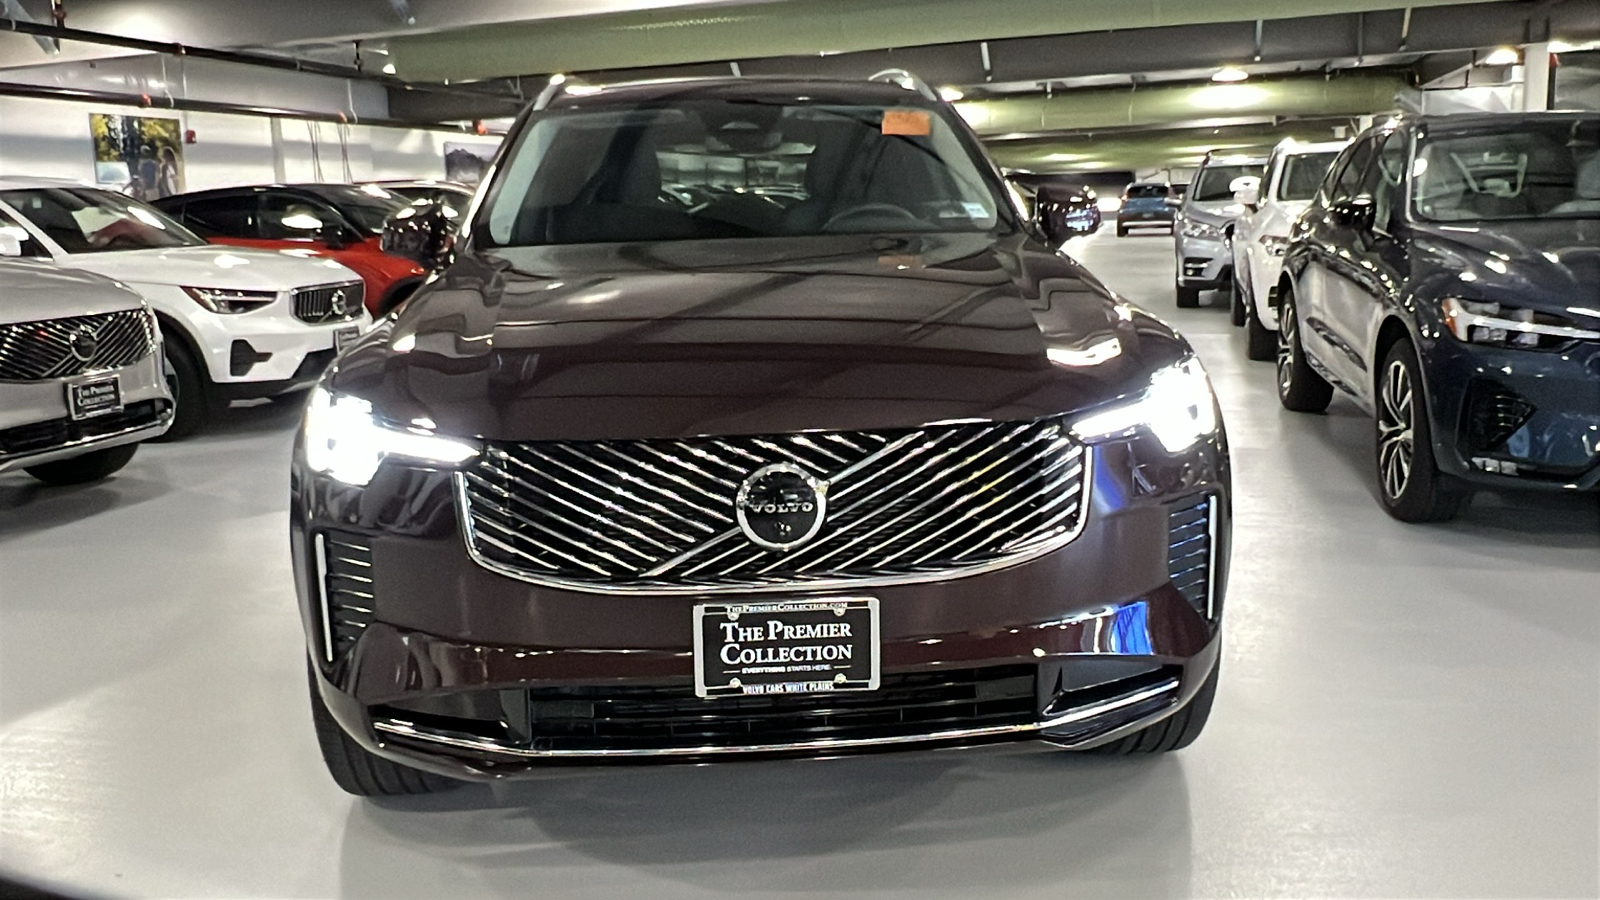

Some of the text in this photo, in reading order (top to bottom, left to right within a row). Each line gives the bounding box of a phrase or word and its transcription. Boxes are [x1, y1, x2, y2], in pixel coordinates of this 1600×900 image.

[749, 502, 814, 514] VOLVO
[719, 620, 852, 642] THE PREMIER
[719, 644, 853, 665] COLLECTION
